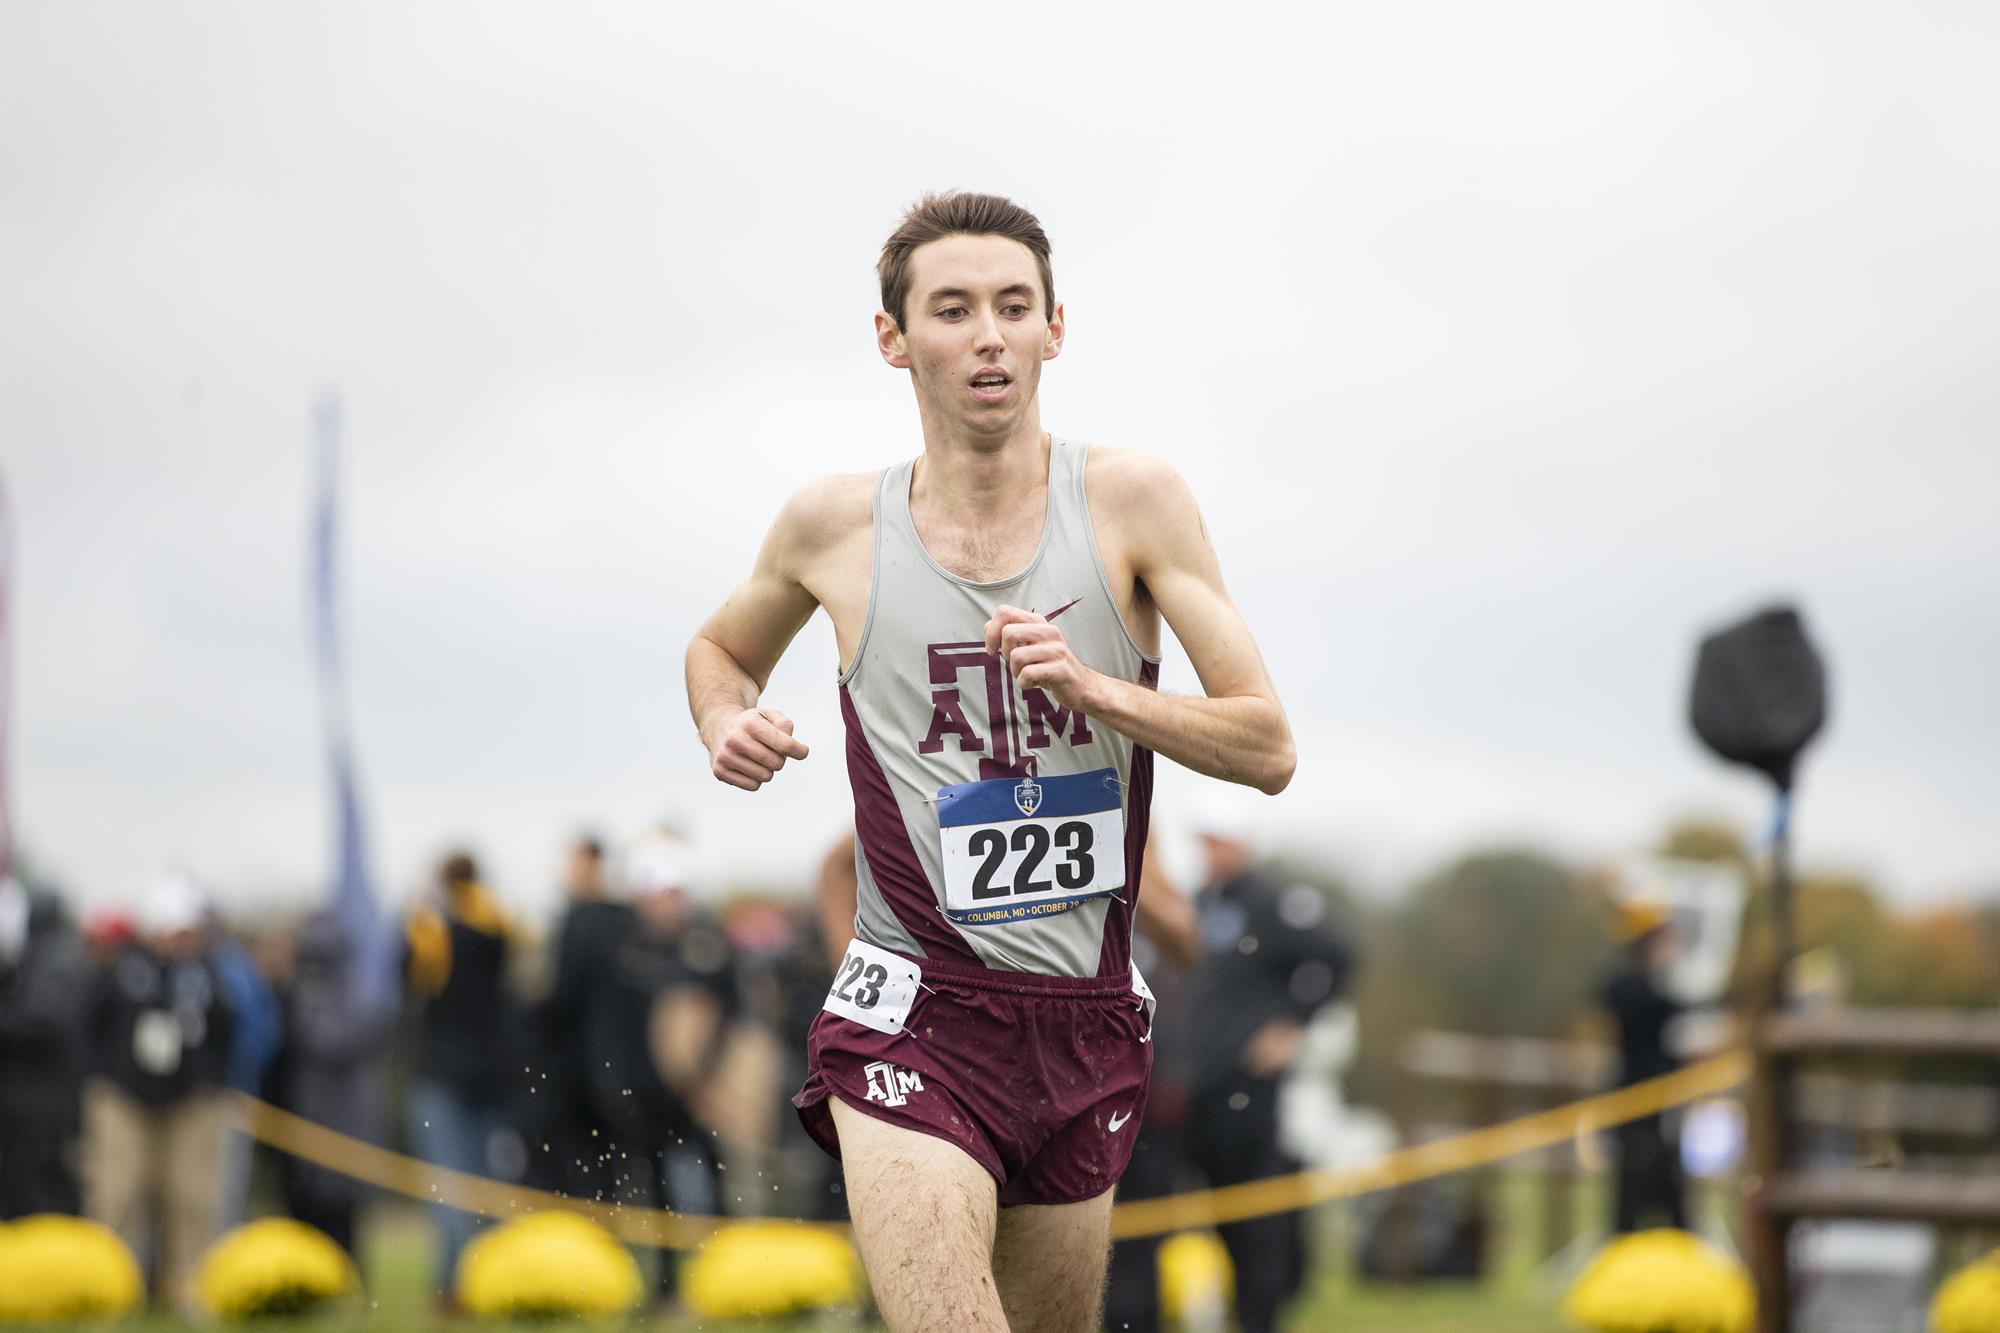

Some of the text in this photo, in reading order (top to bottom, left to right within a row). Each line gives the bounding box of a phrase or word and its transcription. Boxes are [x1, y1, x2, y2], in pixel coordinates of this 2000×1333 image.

[968, 821, 1095, 901] 223
[967, 910, 1011, 922] COLUMBIA,
[1013, 908, 1025, 918] MO
[1031, 901, 1067, 915] OCTOBER
